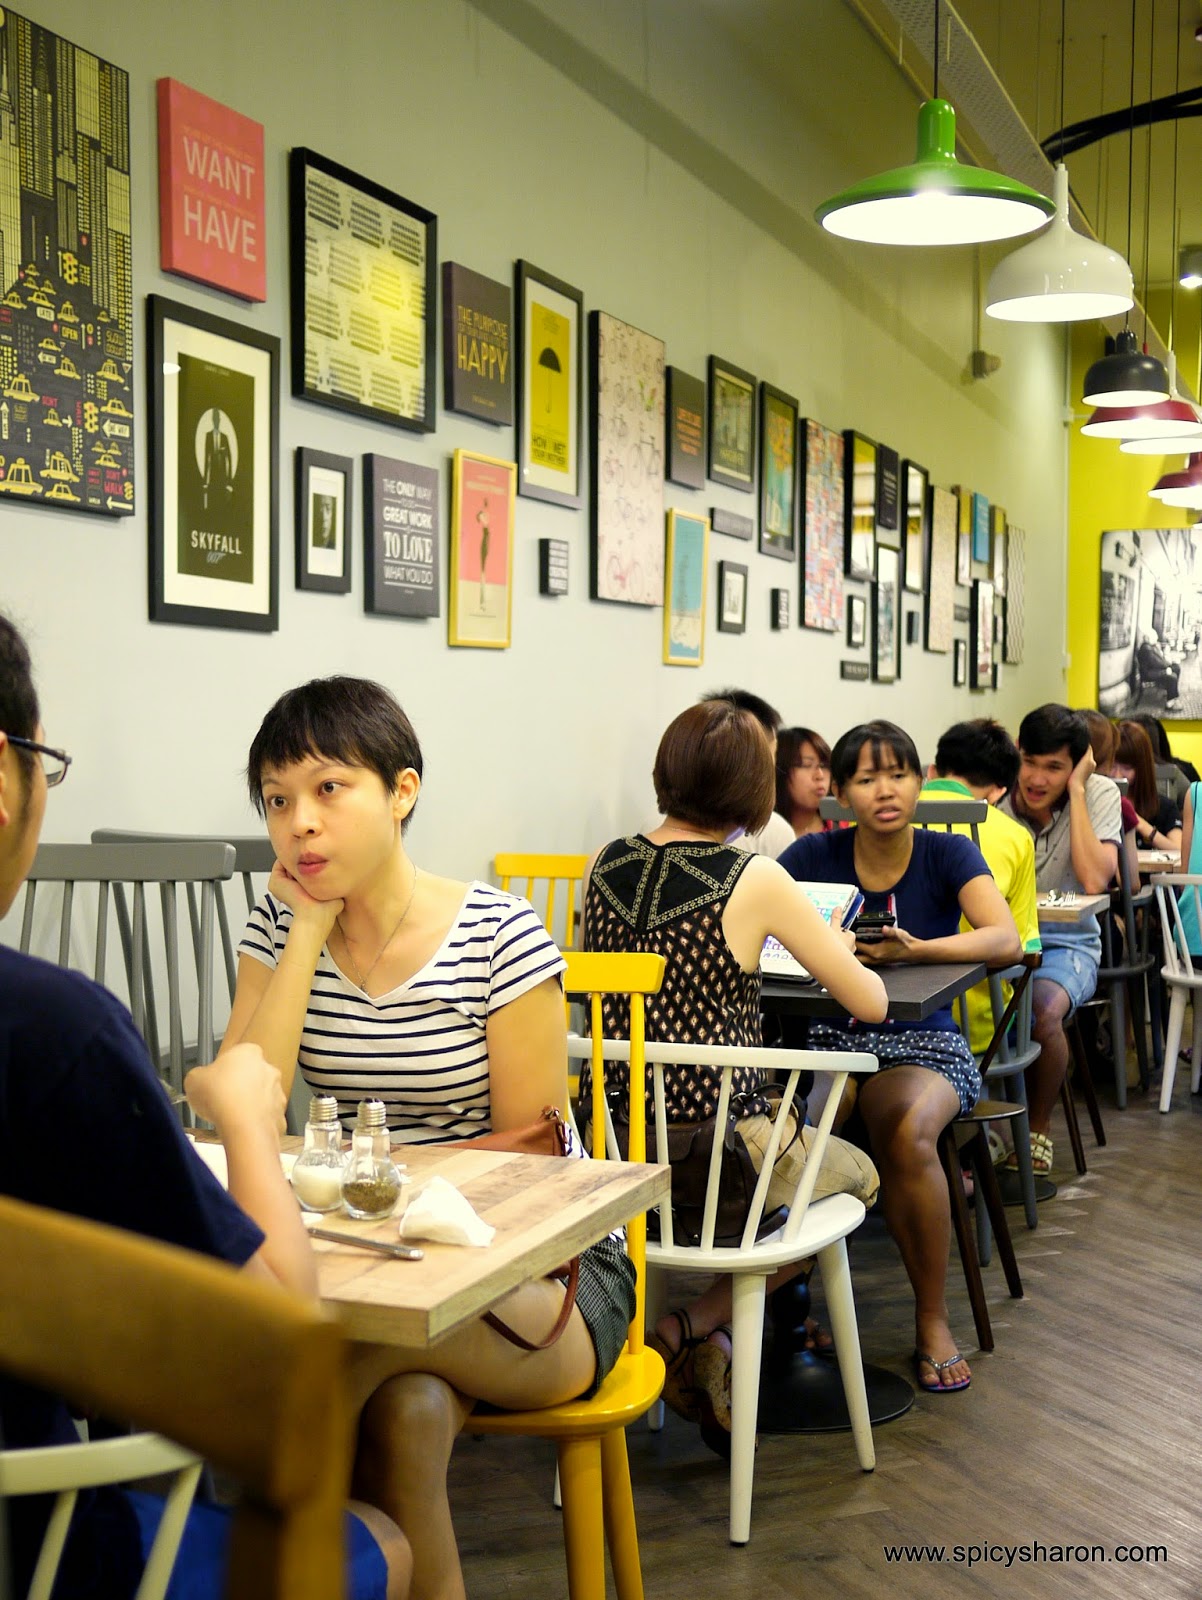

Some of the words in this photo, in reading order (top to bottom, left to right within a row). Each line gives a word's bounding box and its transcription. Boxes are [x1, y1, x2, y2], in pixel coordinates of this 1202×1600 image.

[182, 135, 256, 200] WANT
[183, 194, 257, 263] HAVE
[457, 305, 473, 326] THE
[61, 326, 79, 341] OPEN
[457, 333, 509, 384] HAPPY
[382, 478, 396, 494] THE
[396, 481, 416, 499] ONLY
[382, 505, 409, 525] GREAT
[408, 510, 433, 530] WORK
[190, 529, 242, 556] SKYFALL
[382, 531, 401, 559] TO
[402, 534, 434, 564] LOVE
[382, 564, 406, 582] WHAT
[405, 567, 421, 584] YOU
[421, 569, 434, 585] DO
